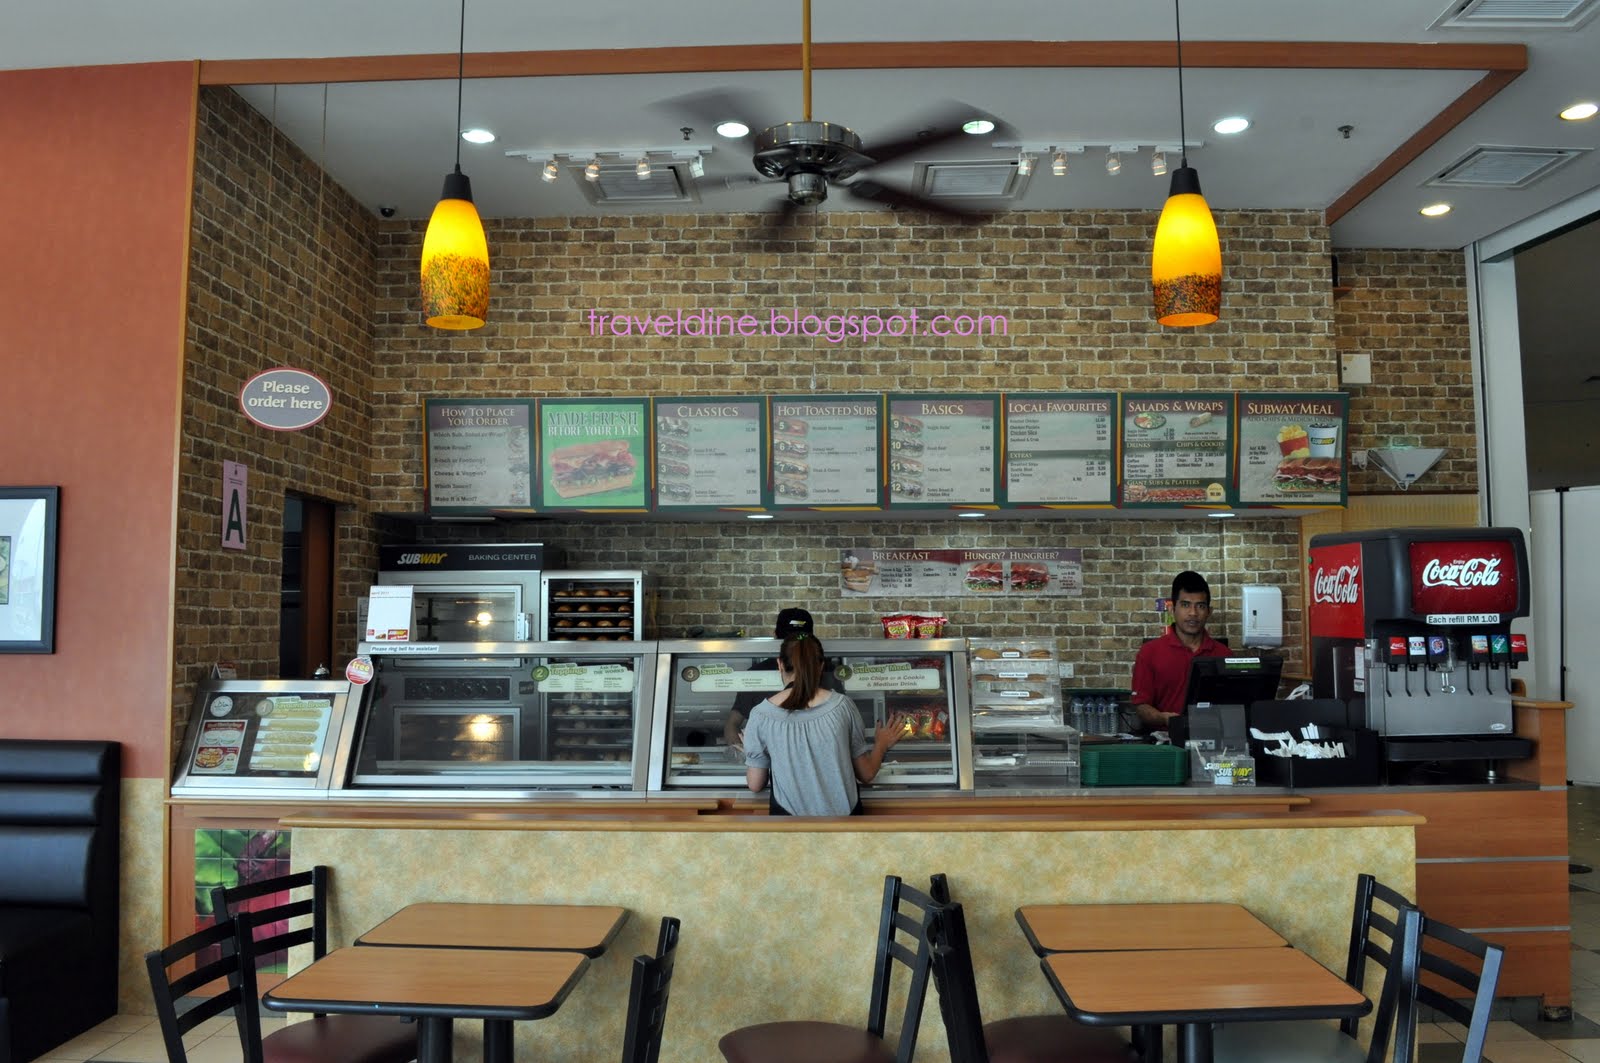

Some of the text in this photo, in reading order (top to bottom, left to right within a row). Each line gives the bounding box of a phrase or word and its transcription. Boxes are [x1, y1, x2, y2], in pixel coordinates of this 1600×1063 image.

[263, 381, 310, 394] Please
[248, 396, 322, 410] order here
[1009, 402, 1108, 413] LOCAL FAVOURITES
[1128, 401, 1224, 412] SALADS & WRAPS
[1248, 402, 1334, 415] SUBWAY MEAL
[441, 408, 516, 417] HOW TO PLACE
[678, 406, 739, 418] CLASSICS
[778, 405, 877, 416] HOT TOASTED SUBS
[922, 404, 964, 415] BASICS
[448, 417, 509, 426] YOUR ORDER
[548, 412, 638, 426] MADE FRESH
[548, 426, 639, 436] BEFORE YOUR EYES
[225, 488, 244, 544] A
[397, 553, 448, 564] SUBWAY
[872, 551, 1059, 560] BREAKFAST HUNGRY? HUNGRIER?
[1422, 558, 1501, 587] Coca-Cola
[1314, 565, 1359, 604] Coca-Cola
[352, 661, 370, 672] free
[537, 668, 587, 678] 2 Toppings
[687, 670, 694, 678] 3
[840, 669, 846, 677] 4
[1216, 768, 1252, 777] SUBWAY
